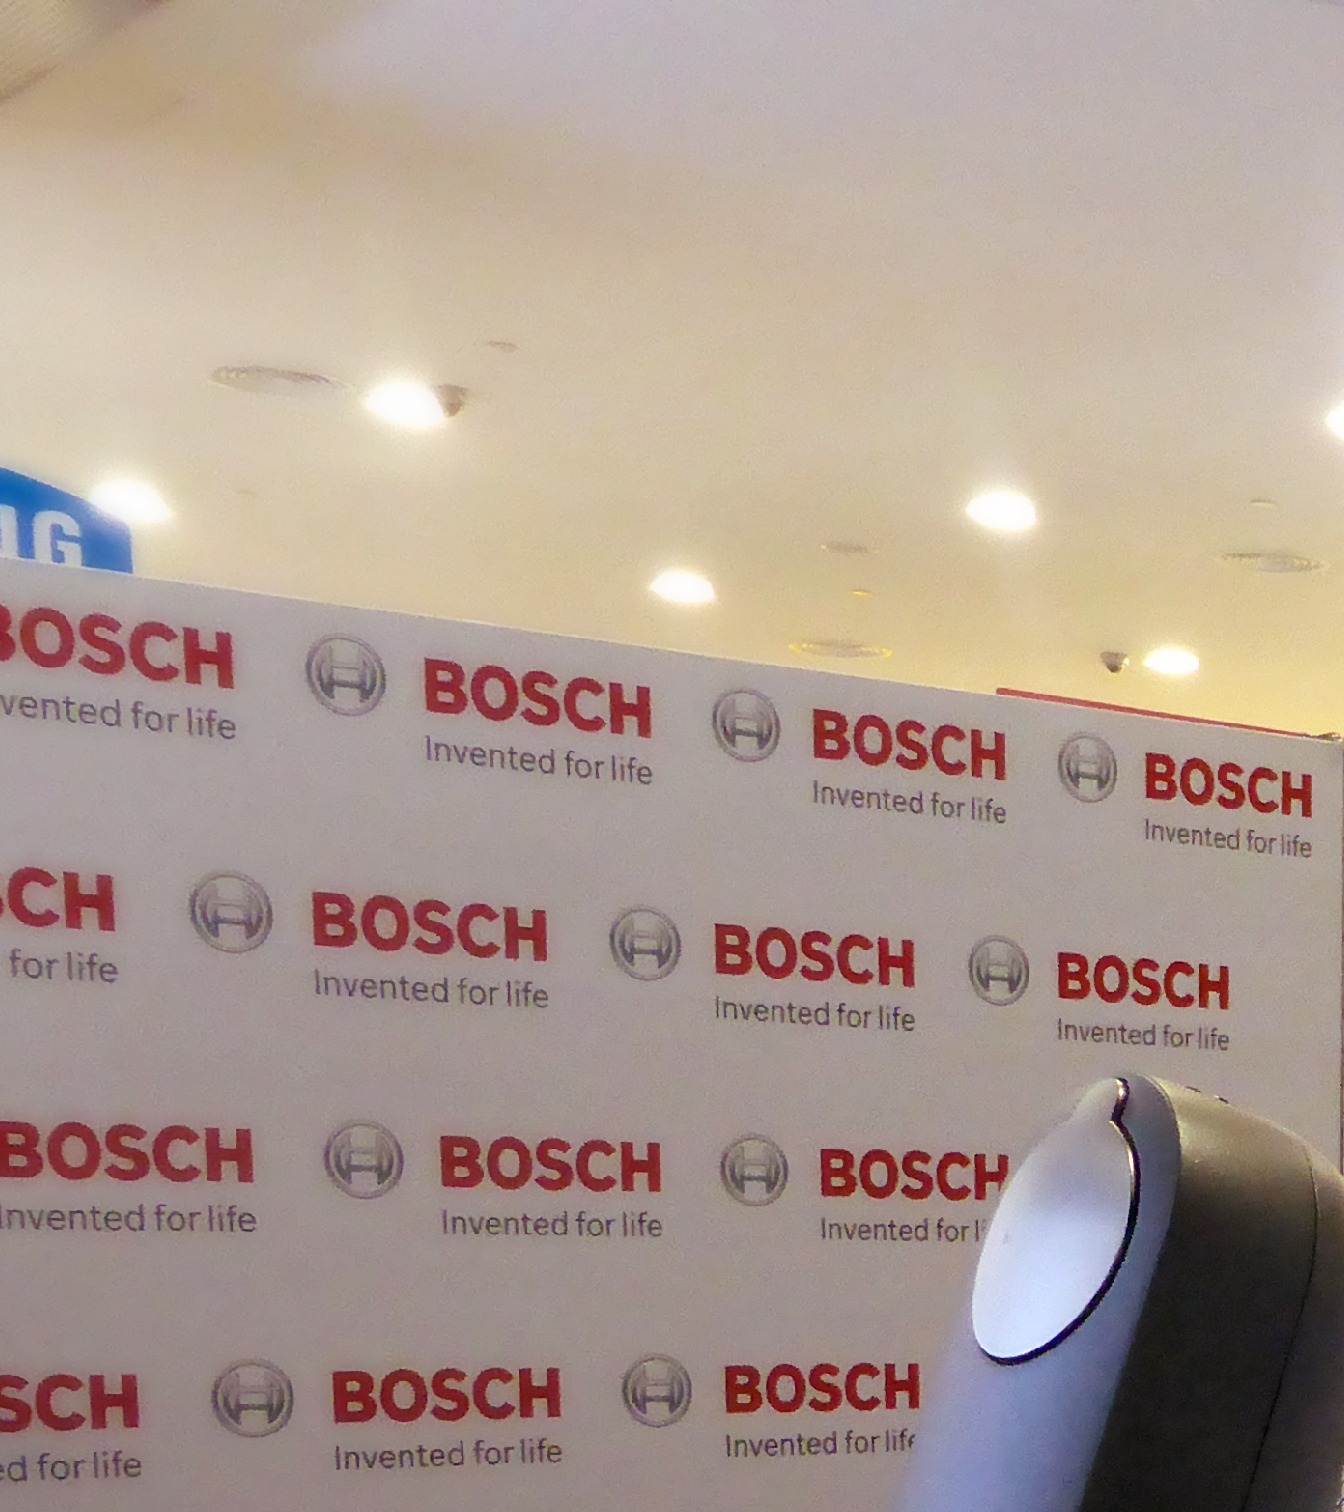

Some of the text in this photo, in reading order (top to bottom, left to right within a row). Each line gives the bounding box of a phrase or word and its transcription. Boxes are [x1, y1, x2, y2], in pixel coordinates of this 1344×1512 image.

[0, 695, 237, 741] vented for life
[424, 658, 652, 739] BOSCH
[425, 735, 653, 786] Invented for life
[813, 709, 1007, 780] BOSCH
[813, 779, 1007, 824] Invented for life
[1144, 752, 1313, 818] BOSCH
[1144, 819, 1312, 859] Invented for life
[312, 892, 548, 962] BOSCH
[9, 948, 118, 985] for life
[714, 923, 916, 988] BOSCH
[313, 968, 549, 1009] Invented for life
[1057, 952, 1230, 1010] BOSCH
[713, 995, 915, 1033] Invented for life
[1057, 1017, 1230, 1052] Invented for life
[0, 1121, 255, 1183] BOSCH
[439, 1135, 662, 1193] BOSCH
[820, 1148, 1010, 1201] BOSCH
[154, 1205, 201, 1233] for
[207, 1205, 257, 1233] life
[443, 1209, 663, 1238] Invented for life
[821, 1217, 929, 1241] Invented
[937, 1217, 970, 1242] for
[0, 1375, 140, 1434] SCH
[332, 1367, 562, 1424] BOSCH
[725, 1363, 921, 1414] BOSCH
[38, 1452, 84, 1479] for
[93, 1450, 142, 1478] life
[335, 1438, 562, 1471] Invented for life
[726, 1430, 837, 1457] Invented
[845, 1430, 880, 1454] for
